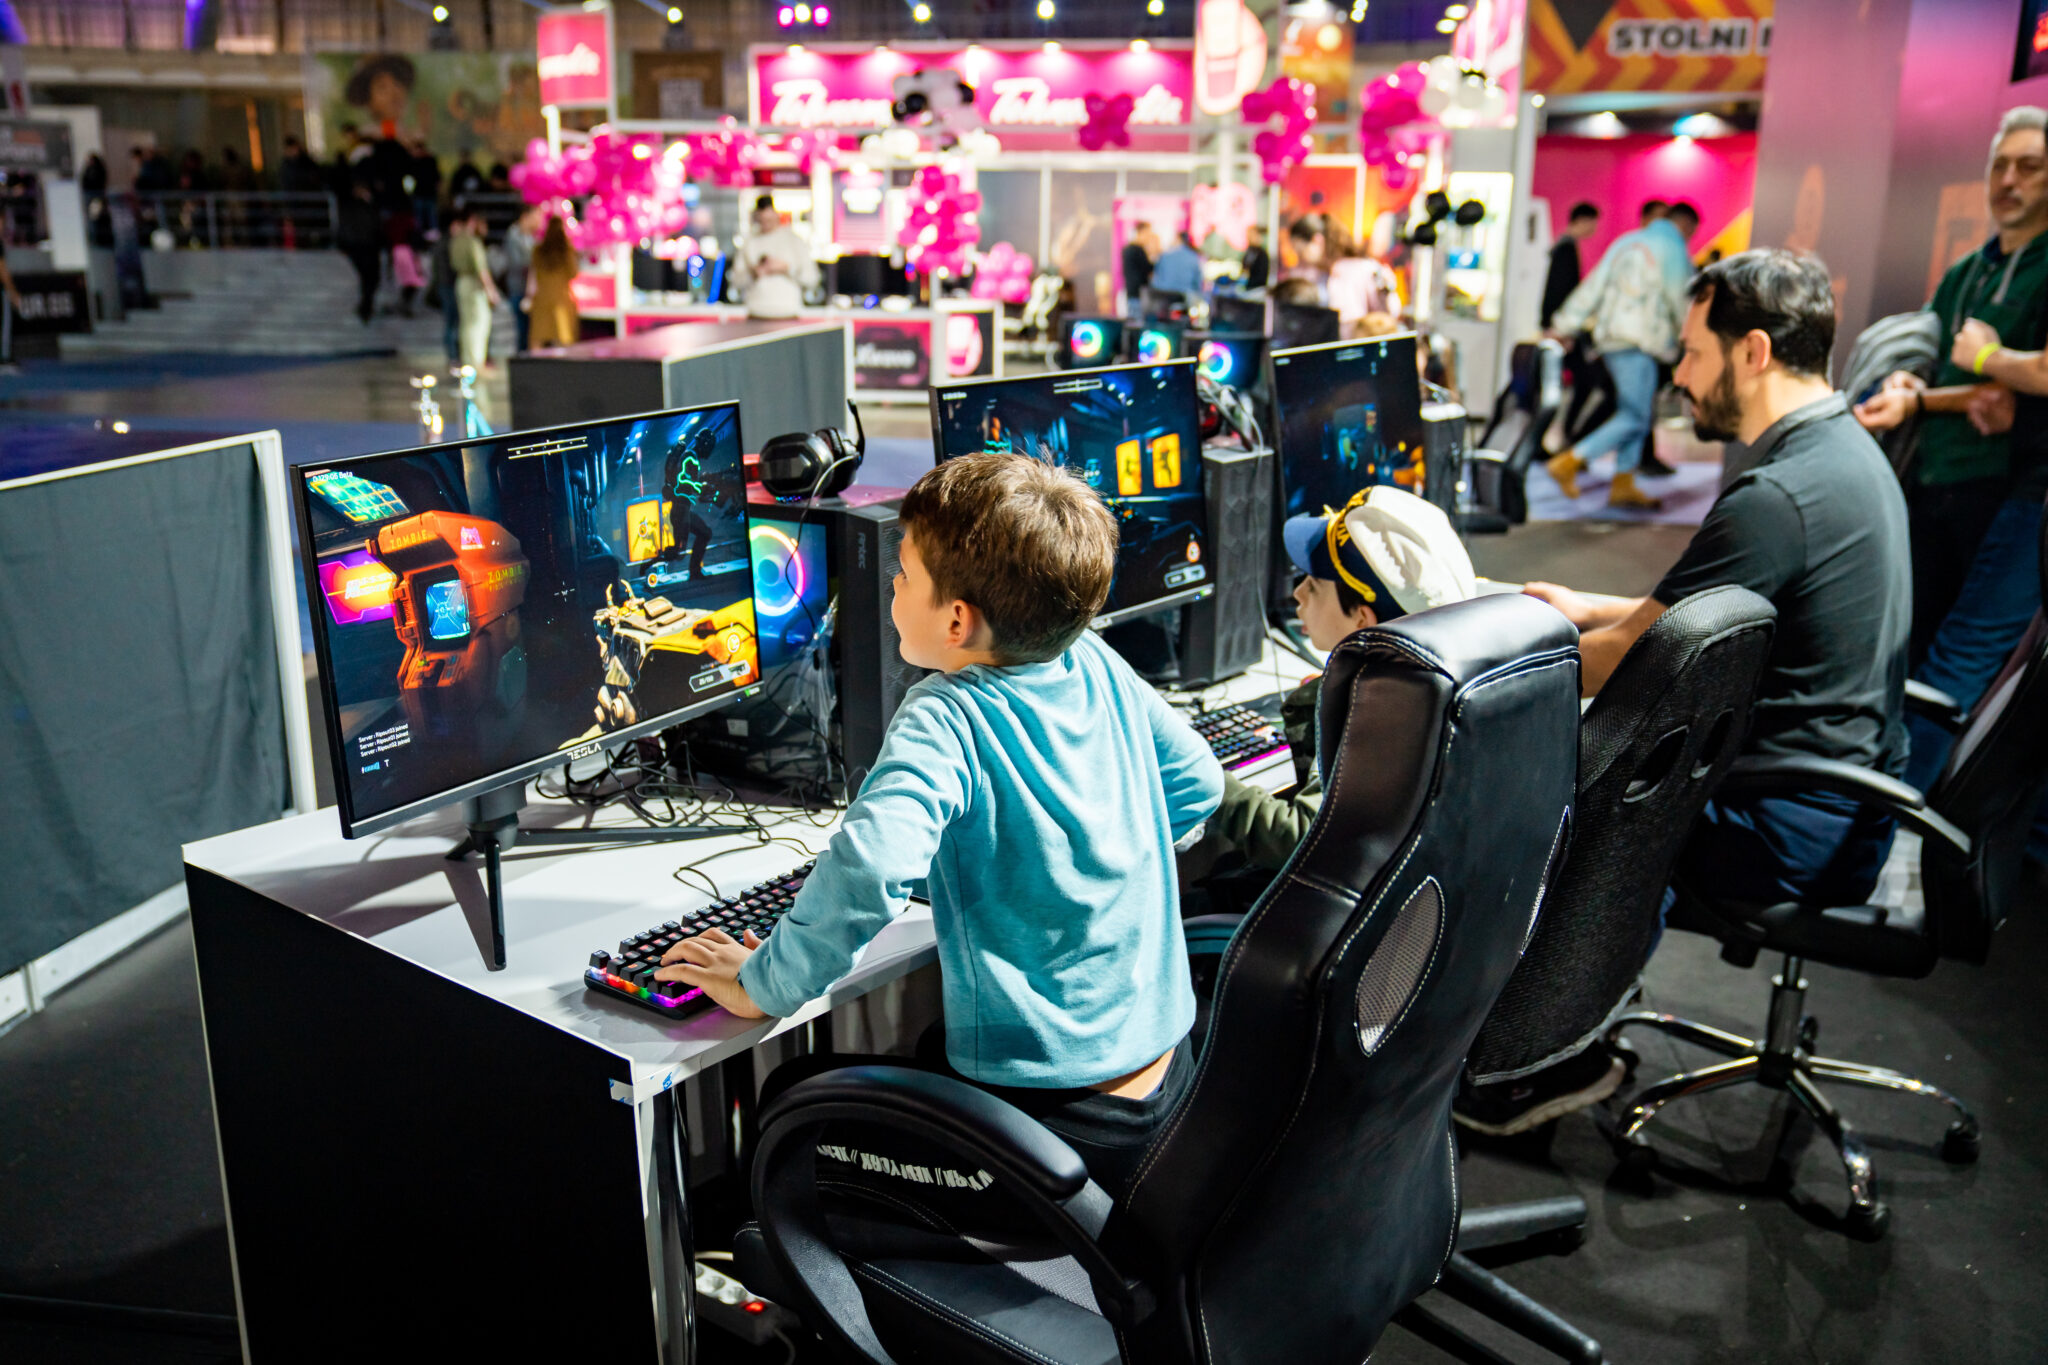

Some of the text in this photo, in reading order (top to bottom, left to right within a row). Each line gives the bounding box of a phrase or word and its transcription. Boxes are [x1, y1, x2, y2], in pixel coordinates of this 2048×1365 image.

[1613, 23, 1749, 52] STOLNI
[389, 529, 427, 549] ZOMBIE
[488, 565, 522, 583] ZOMBIE
[359, 735, 373, 743] Server
[396, 723, 408, 733] joined
[360, 742, 374, 750] Server
[396, 730, 408, 740] joined
[361, 749, 375, 757] Server
[397, 737, 410, 746] joined
[566, 742, 602, 760] TESLA
[384, 759, 390, 767] T
